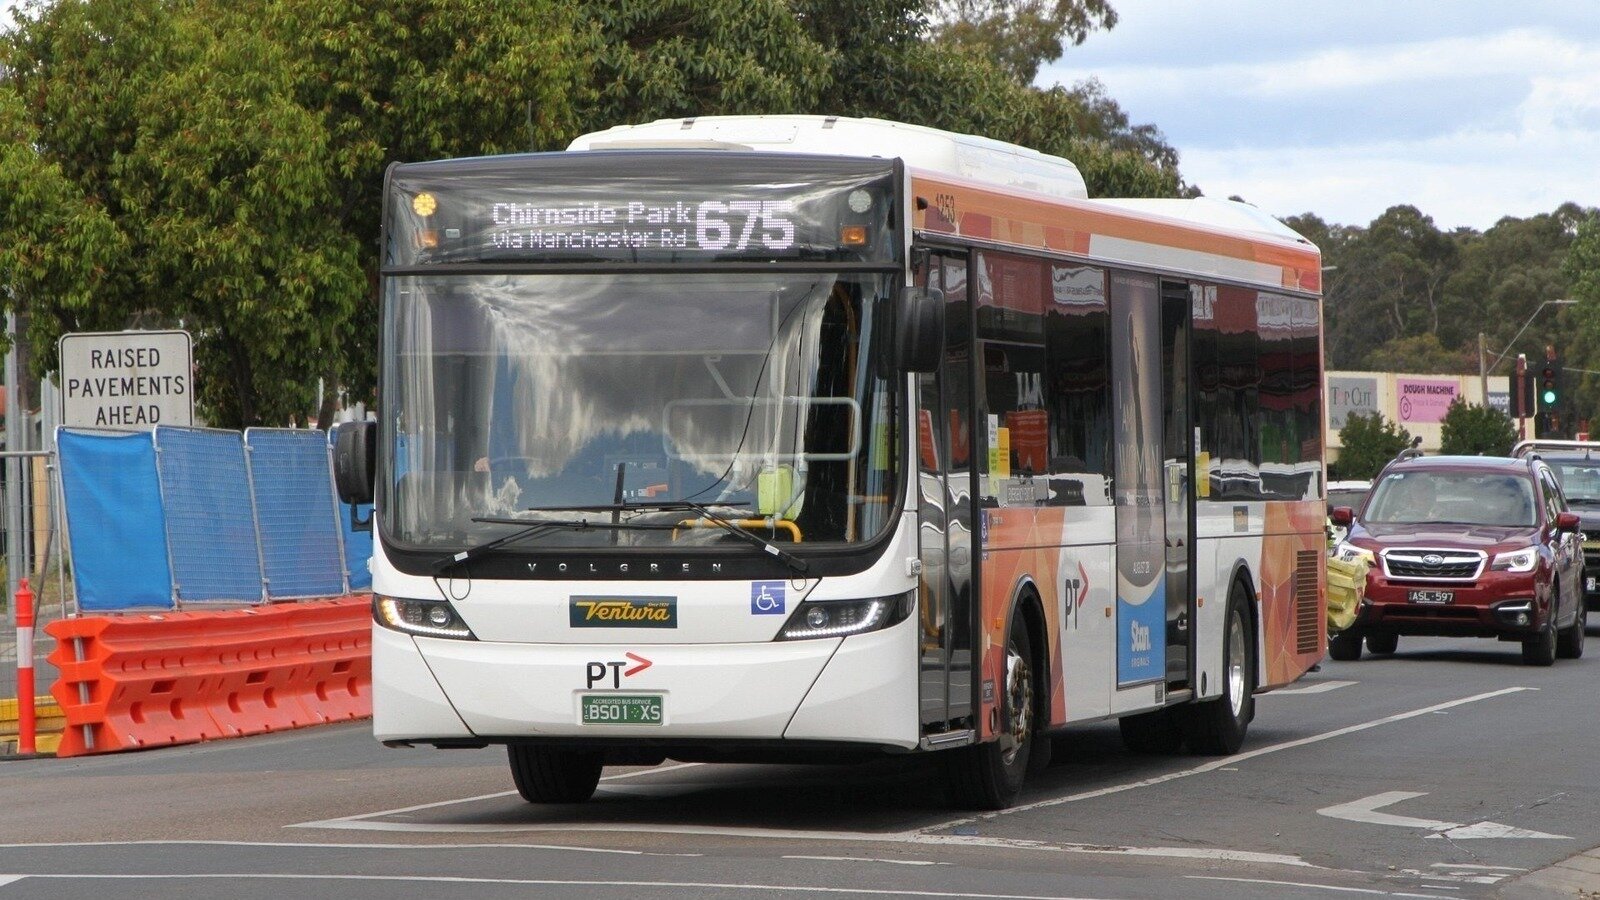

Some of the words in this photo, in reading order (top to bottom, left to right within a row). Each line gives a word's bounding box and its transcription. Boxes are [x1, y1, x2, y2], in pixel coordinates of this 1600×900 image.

[493, 203, 616, 224] Chirnside
[629, 201, 690, 223] Park
[696, 200, 794, 250] 675
[493, 230, 523, 248] via
[530, 229, 653, 248] Manchester
[661, 229, 686, 247] Rd
[92, 348, 160, 369] RAISED
[68, 375, 185, 398] PAVEMENTS
[1403, 384, 1425, 394] DOUGH
[1426, 385, 1454, 395] MACHINE
[96, 405, 160, 425] AHEAD
[528, 563, 722, 572] VOLGREN
[1065, 578, 1080, 630] PT
[1435, 593, 1453, 602] 597
[576, 601, 670, 620] Ventura
[586, 661, 627, 689] PT
[589, 704, 627, 720] BS01
[640, 704, 660, 720] XS
